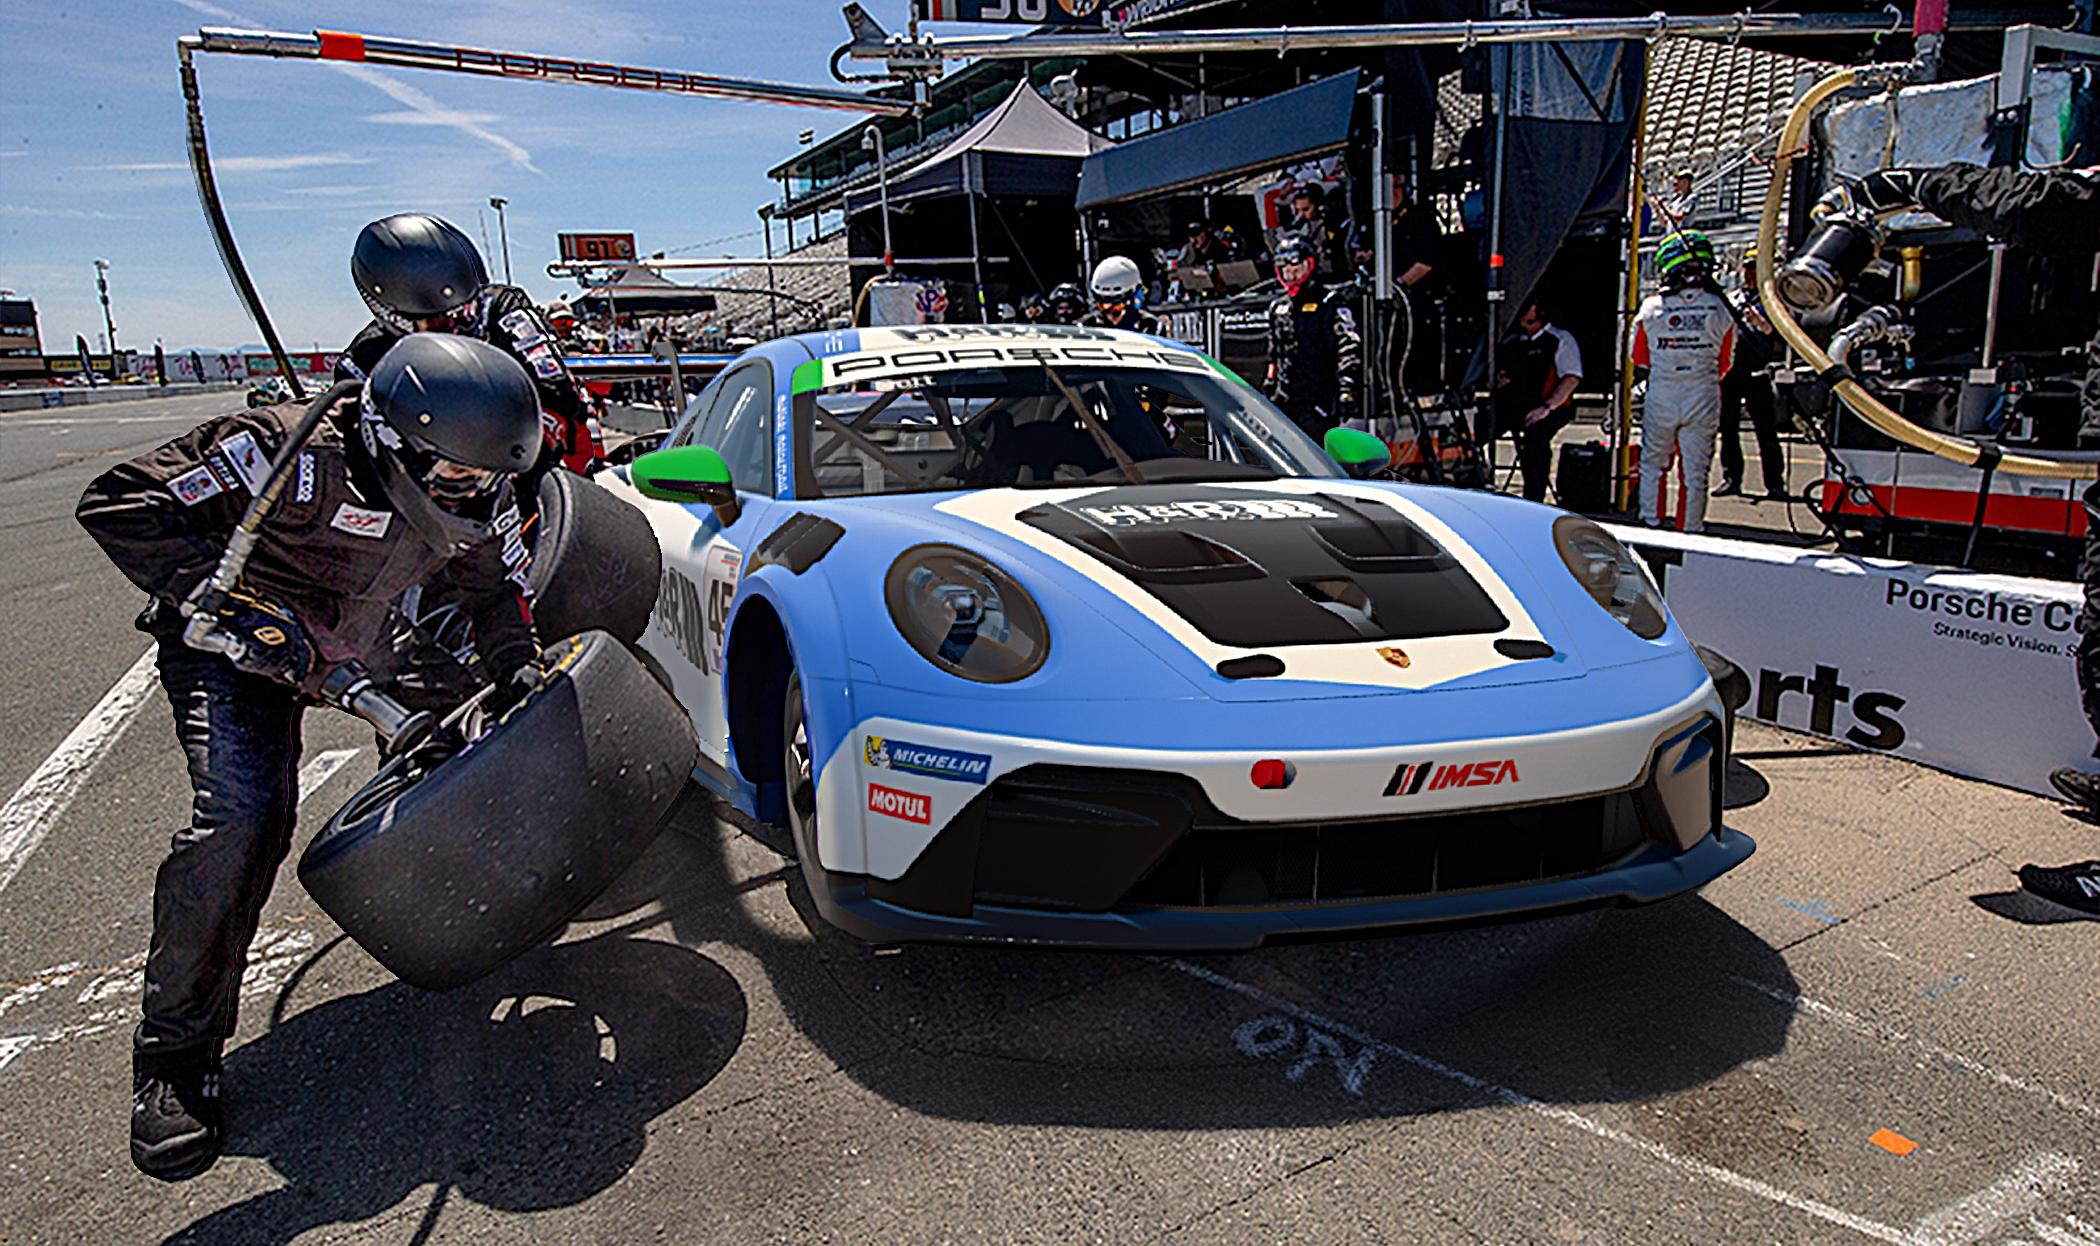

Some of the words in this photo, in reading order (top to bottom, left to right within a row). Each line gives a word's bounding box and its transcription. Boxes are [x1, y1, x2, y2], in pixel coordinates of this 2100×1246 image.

[457, 48, 721, 93] PORSCHE
[832, 346, 1209, 378] PORSCHE
[1886, 577, 2033, 627] Porsche
[1933, 621, 2004, 647] Strategic
[2006, 633, 2063, 657] Vision.
[893, 748, 987, 774] MICHELIN
[1427, 759, 1520, 791] IMSA
[870, 788, 927, 820] MOTUL
